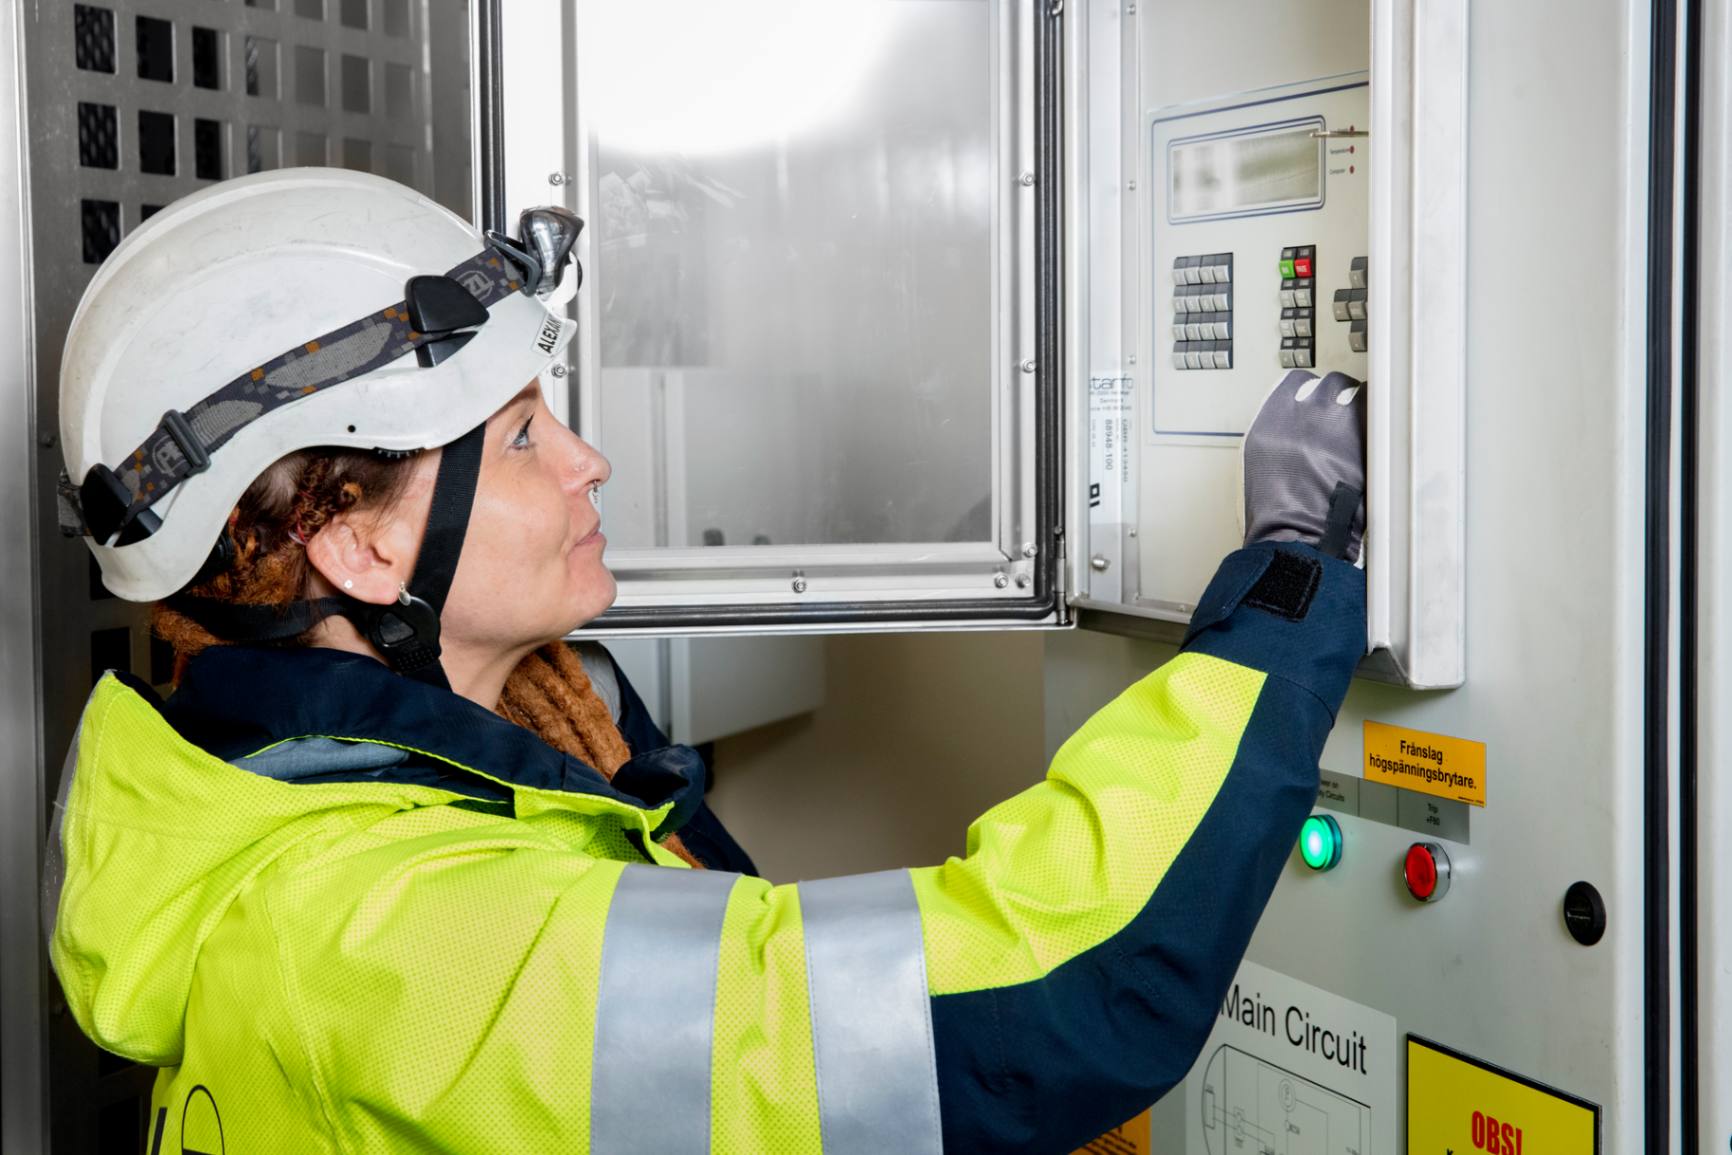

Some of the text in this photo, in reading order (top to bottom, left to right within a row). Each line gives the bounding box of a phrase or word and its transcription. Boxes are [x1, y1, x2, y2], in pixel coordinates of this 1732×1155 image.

[1400, 740, 1443, 765] Frånslag
[1369, 753, 1477, 790] högspänningsbrytare.
[1221, 984, 1367, 1075] Main Circuit
